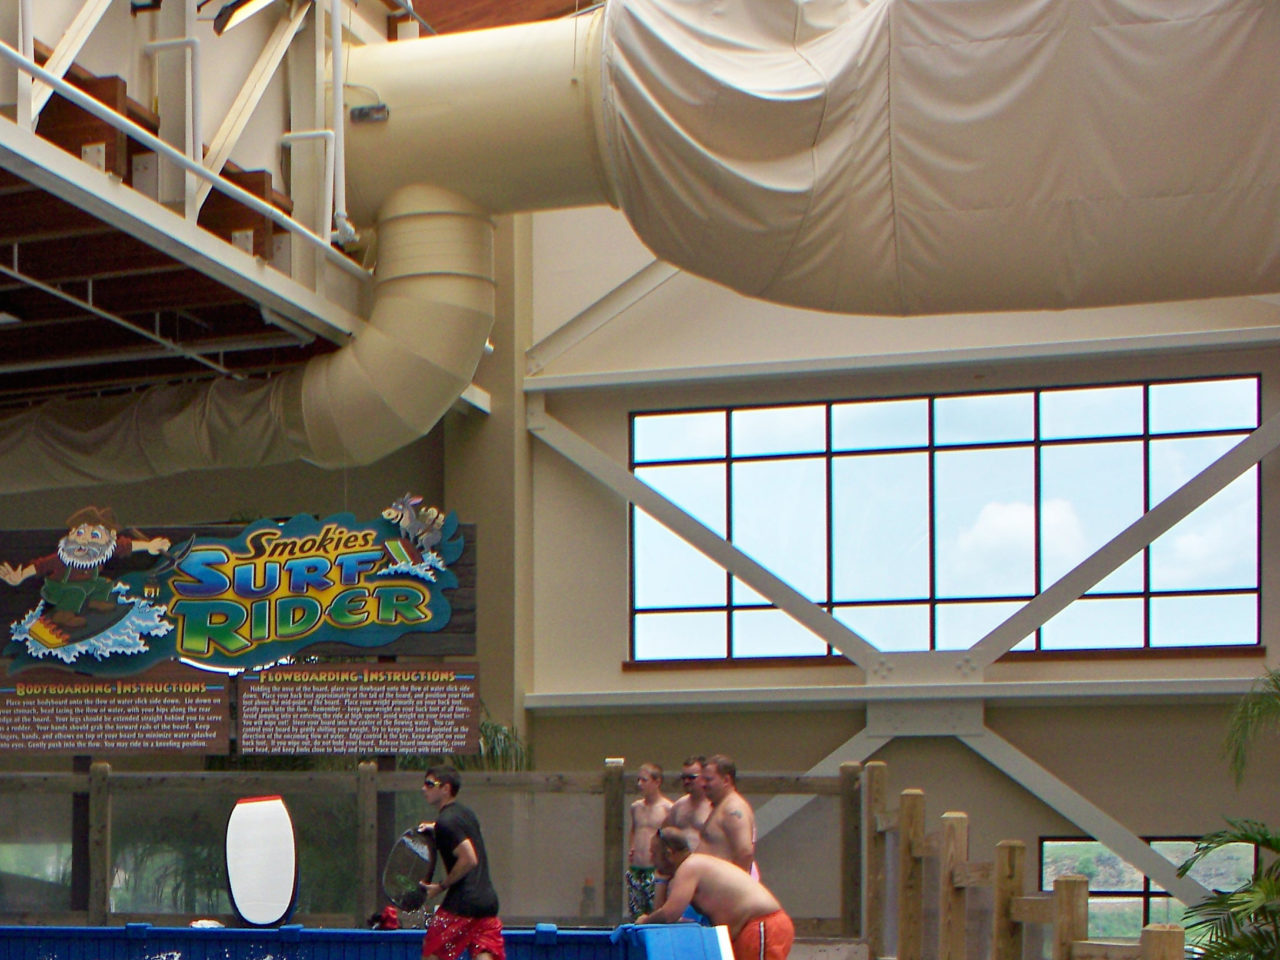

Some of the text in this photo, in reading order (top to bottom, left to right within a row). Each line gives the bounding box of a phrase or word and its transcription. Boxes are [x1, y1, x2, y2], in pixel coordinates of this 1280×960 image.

[236, 525, 373, 559] Smokies
[173, 550, 384, 597] SURF
[172, 587, 425, 654] RIDER
[16, 680, 207, 696] BODYBOARDING INSTRUCTIONS
[260, 668, 456, 683] FLOWBOARDING INSTRUCTIONS
